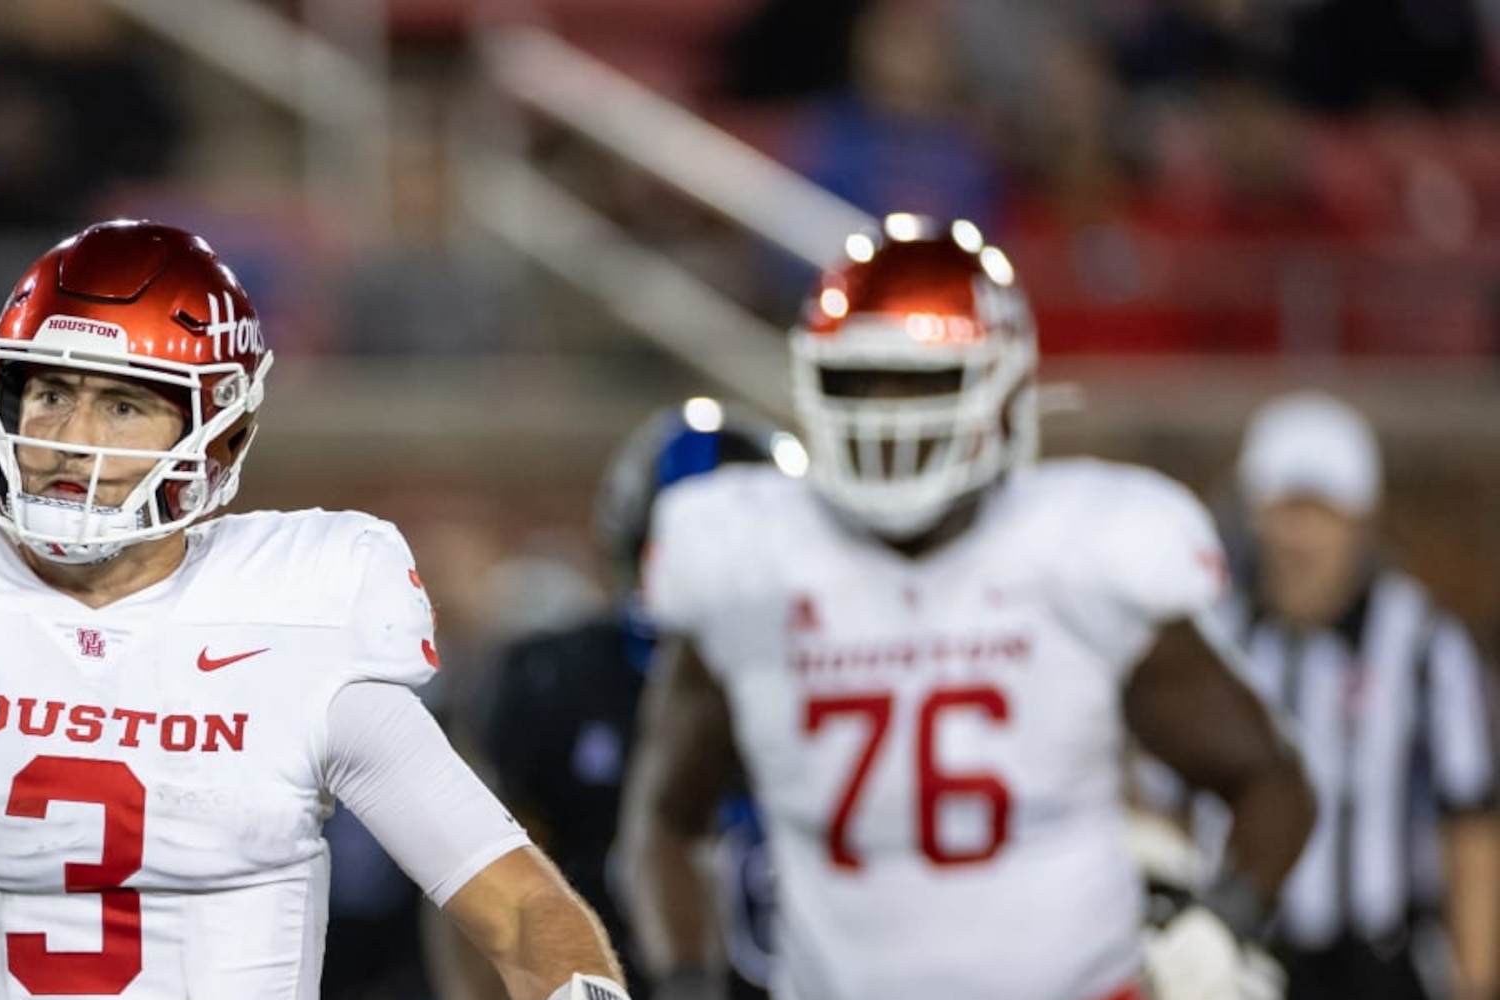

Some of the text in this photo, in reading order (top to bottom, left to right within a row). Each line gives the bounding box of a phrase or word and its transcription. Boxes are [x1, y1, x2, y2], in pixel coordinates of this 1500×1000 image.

[48, 318, 119, 339] HOUSTON
[5, 754, 146, 996] 3
[802, 683, 1012, 875] 76
